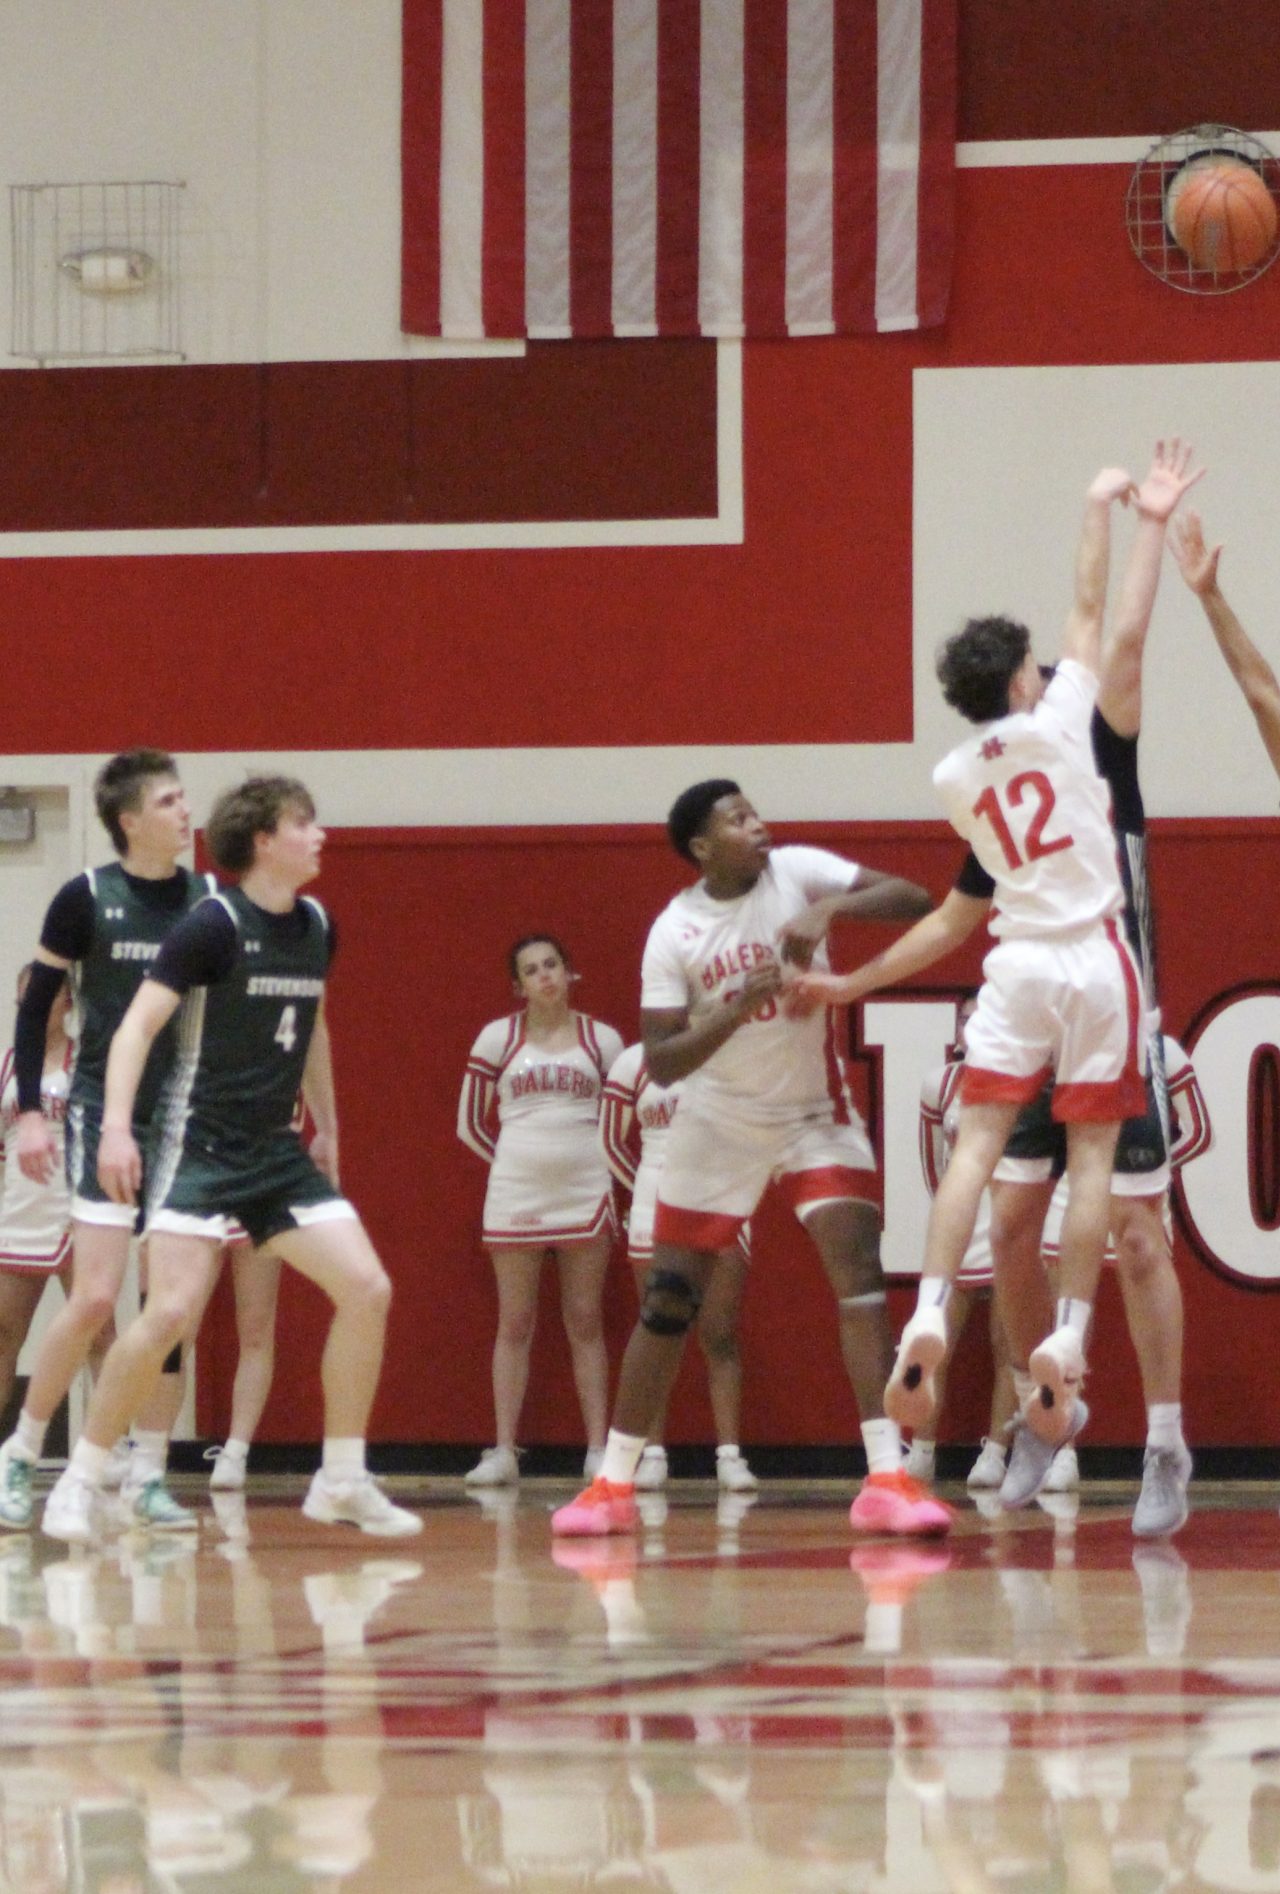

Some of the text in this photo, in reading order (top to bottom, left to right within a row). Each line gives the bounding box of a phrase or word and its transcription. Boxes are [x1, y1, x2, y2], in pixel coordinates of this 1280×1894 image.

[972, 770, 1075, 872] 12
[273, 1004, 298, 1053] 4
[510, 1064, 594, 1099] BALERS
